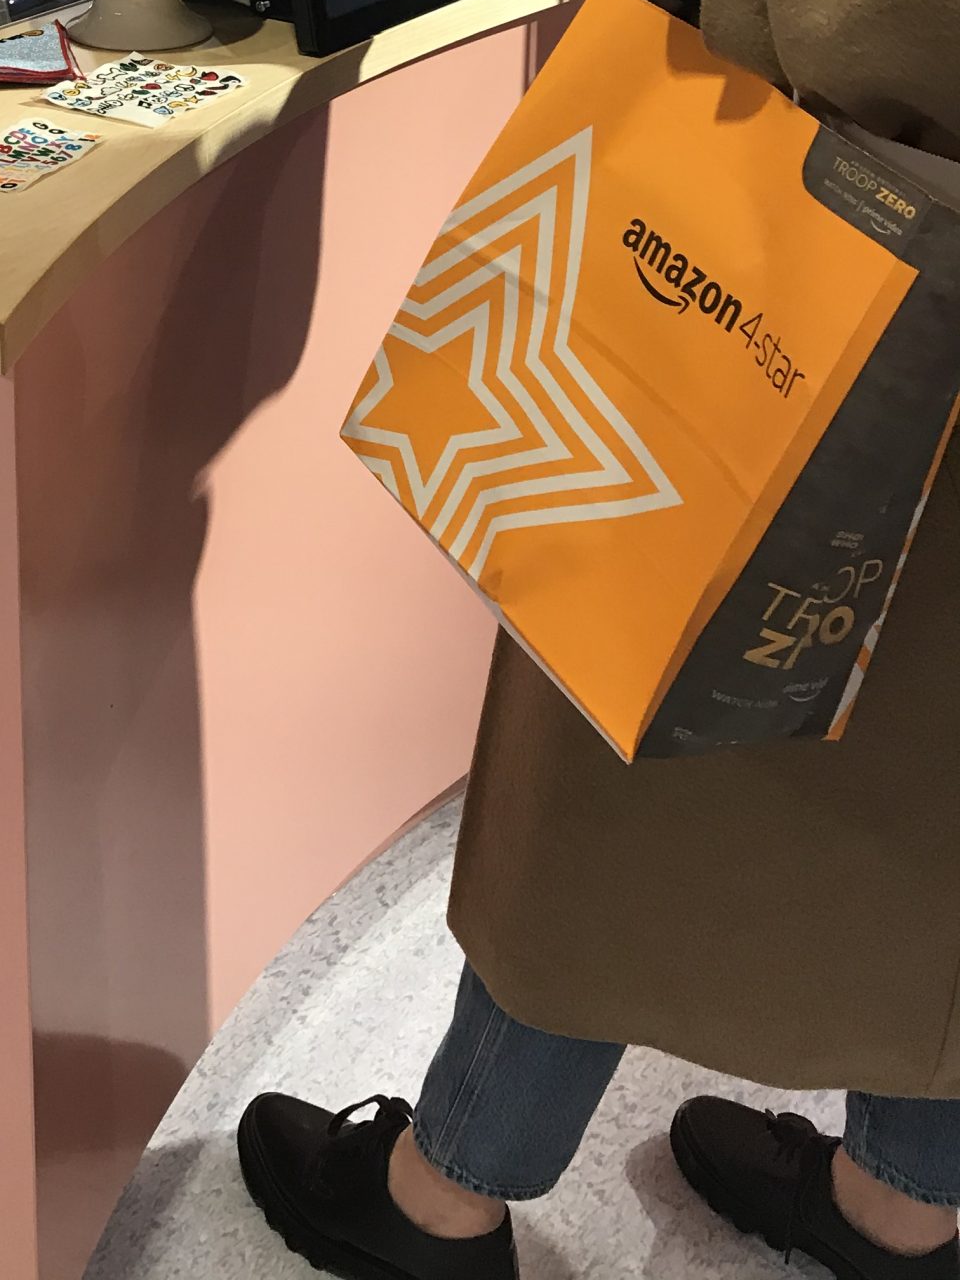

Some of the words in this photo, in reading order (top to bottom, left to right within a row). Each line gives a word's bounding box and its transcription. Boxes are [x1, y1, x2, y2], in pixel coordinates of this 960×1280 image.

[833, 156, 878, 191] TROOP
[875, 187, 916, 219] ZERO
[622, 218, 744, 333] amazon
[740, 312, 805, 399] 4-star
